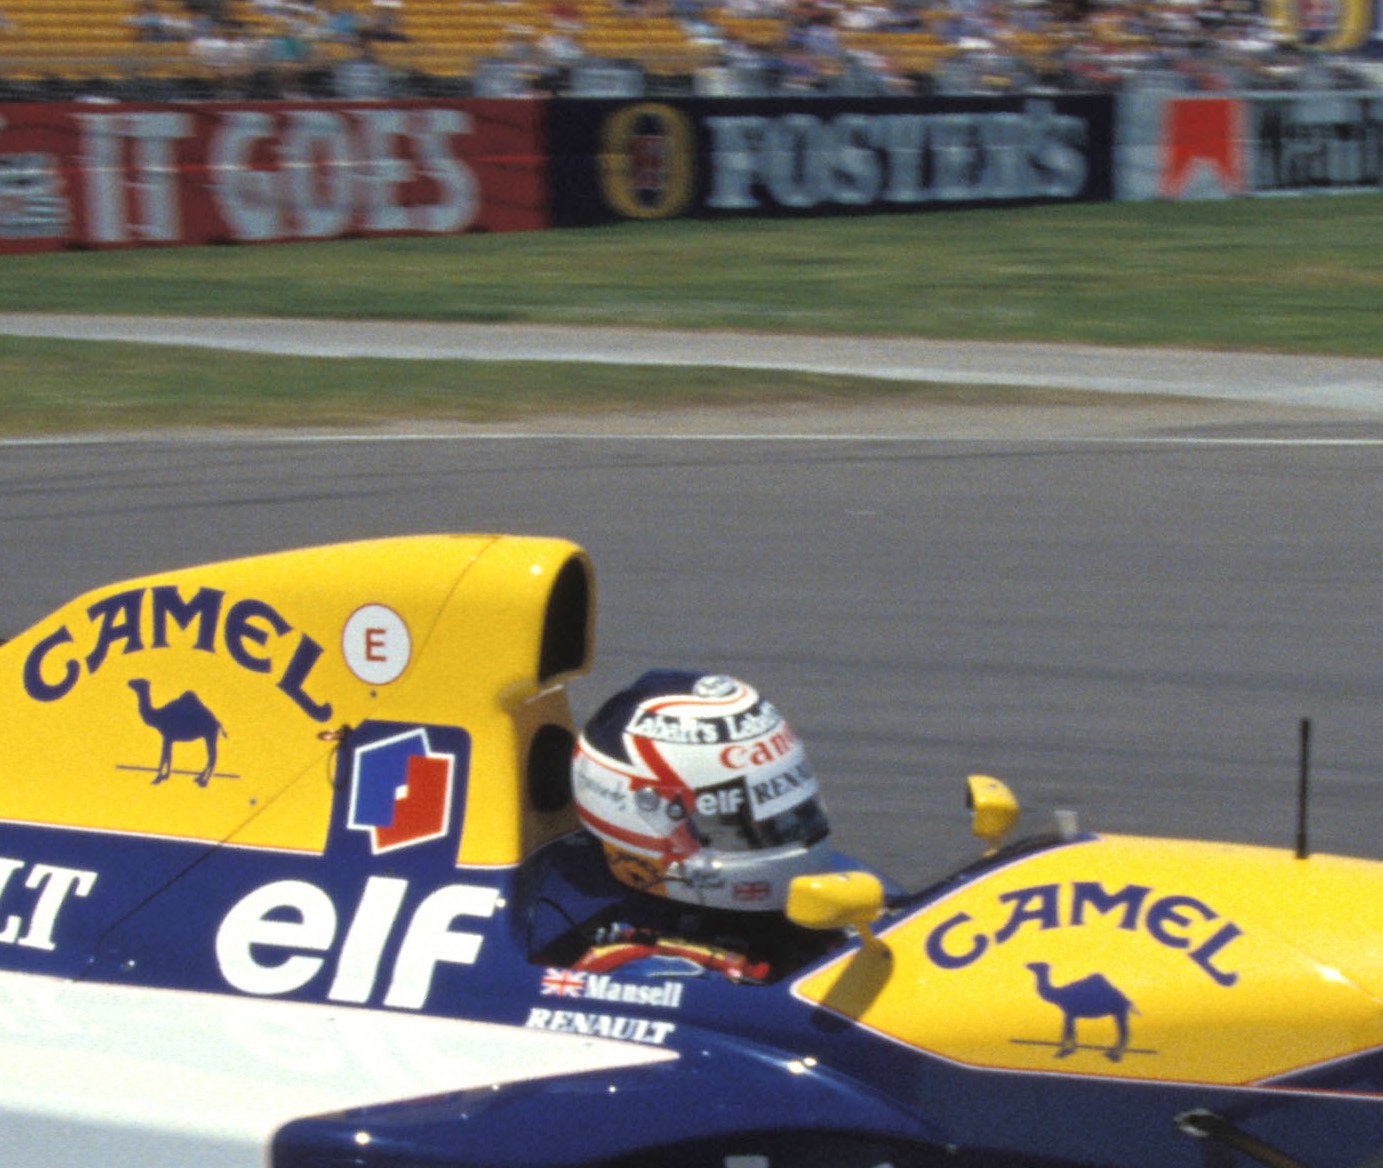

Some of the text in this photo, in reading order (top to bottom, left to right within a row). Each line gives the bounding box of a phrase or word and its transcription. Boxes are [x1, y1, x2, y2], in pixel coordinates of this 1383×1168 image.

[71, 112, 194, 243] IT
[211, 109, 480, 239] GOES
[22, 585, 333, 722] CAMEL
[364, 627, 389, 662] E
[695, 787, 744, 817] elf
[215, 877, 501, 1009] elf
[924, 882, 1245, 987] CAMEL
[524, 1007, 676, 1044] RENAULT
[584, 973, 684, 1008] Mansell
